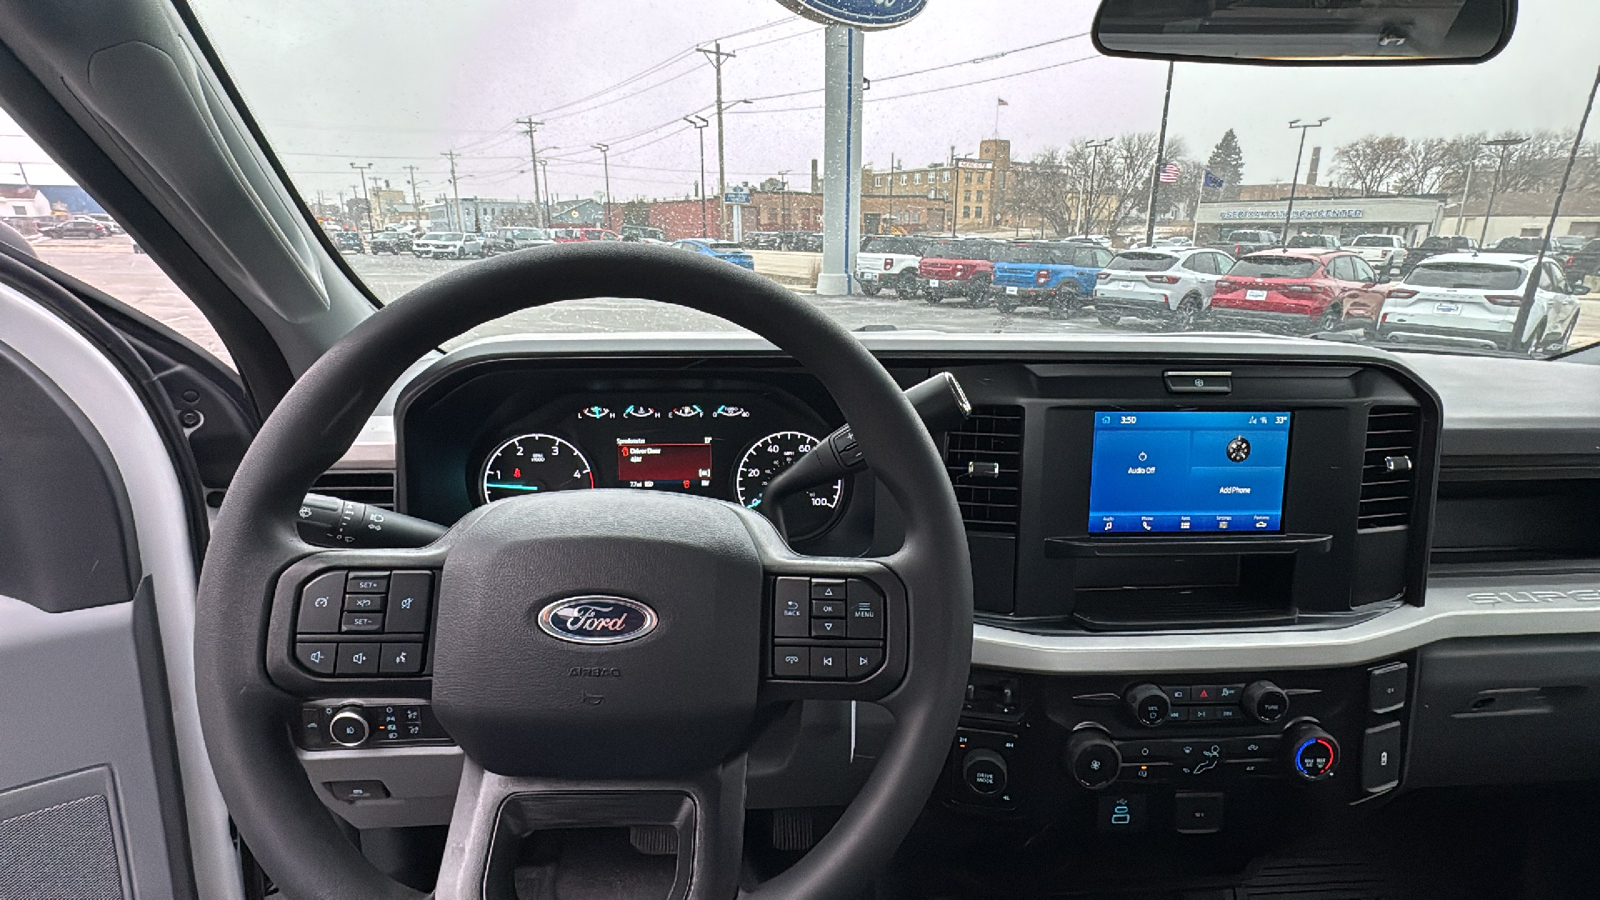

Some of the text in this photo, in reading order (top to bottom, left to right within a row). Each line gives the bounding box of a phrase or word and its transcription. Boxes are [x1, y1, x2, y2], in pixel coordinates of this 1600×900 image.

[1317, 209, 1363, 218] CENTER
[1120, 416, 1137, 424] 3:50
[1275, 416, 1288, 424] 33°
[516, 446, 524, 456] 2
[551, 446, 559, 456] 3
[767, 444, 780, 453] 40
[798, 444, 811, 453] 60
[496, 470, 501, 479] 1
[573, 469, 581, 479] 4
[747, 468, 760, 477] 20
[1127, 466, 1156, 474] Audio Off
[1219, 486, 1251, 494] Add Phone
[811, 497, 827, 506] 100
[359, 581, 378, 589] SET+
[1466, 588, 1600, 607] SUPE
[354, 618, 373, 626] SET-
[566, 604, 627, 631] Ford
[568, 666, 622, 678] AIRBAG
